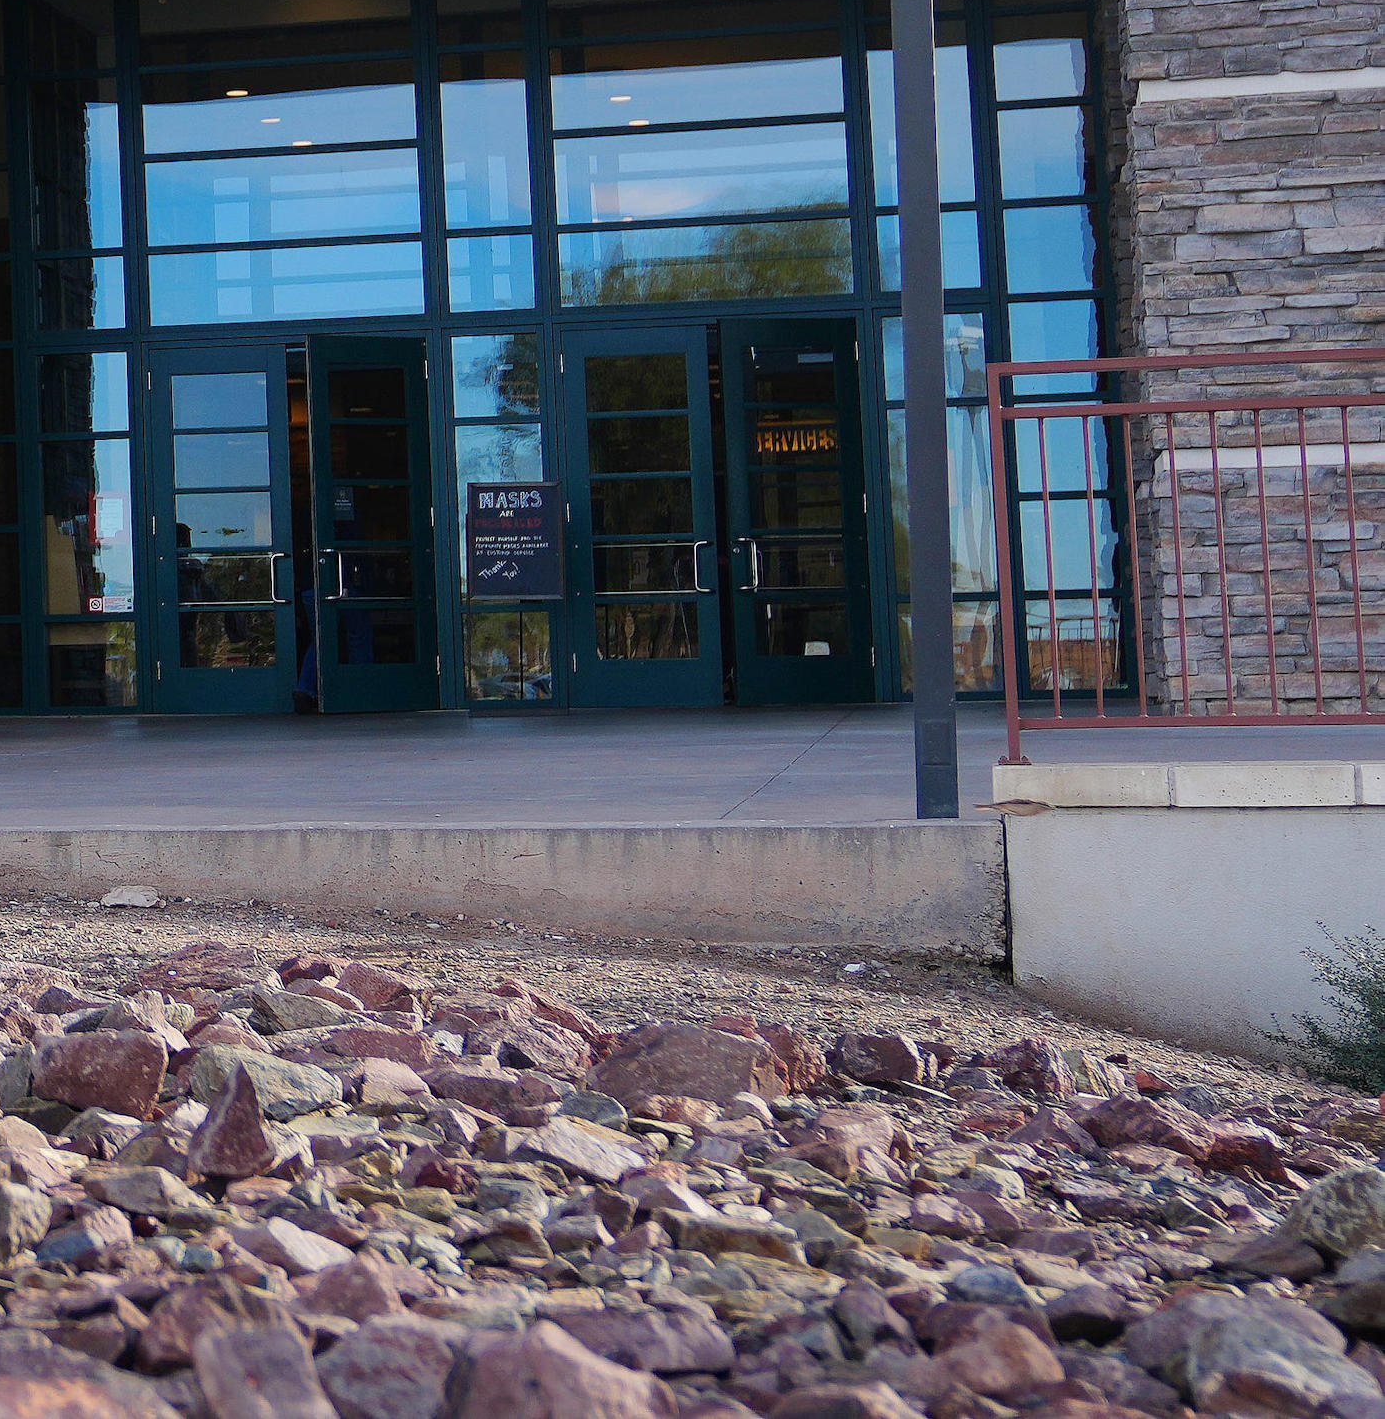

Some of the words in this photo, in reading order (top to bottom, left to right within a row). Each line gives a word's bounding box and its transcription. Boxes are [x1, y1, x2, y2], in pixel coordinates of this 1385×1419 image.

[479, 490, 543, 509] MASKS
[499, 510, 514, 518] ARE
[478, 560, 507, 579] Thank
